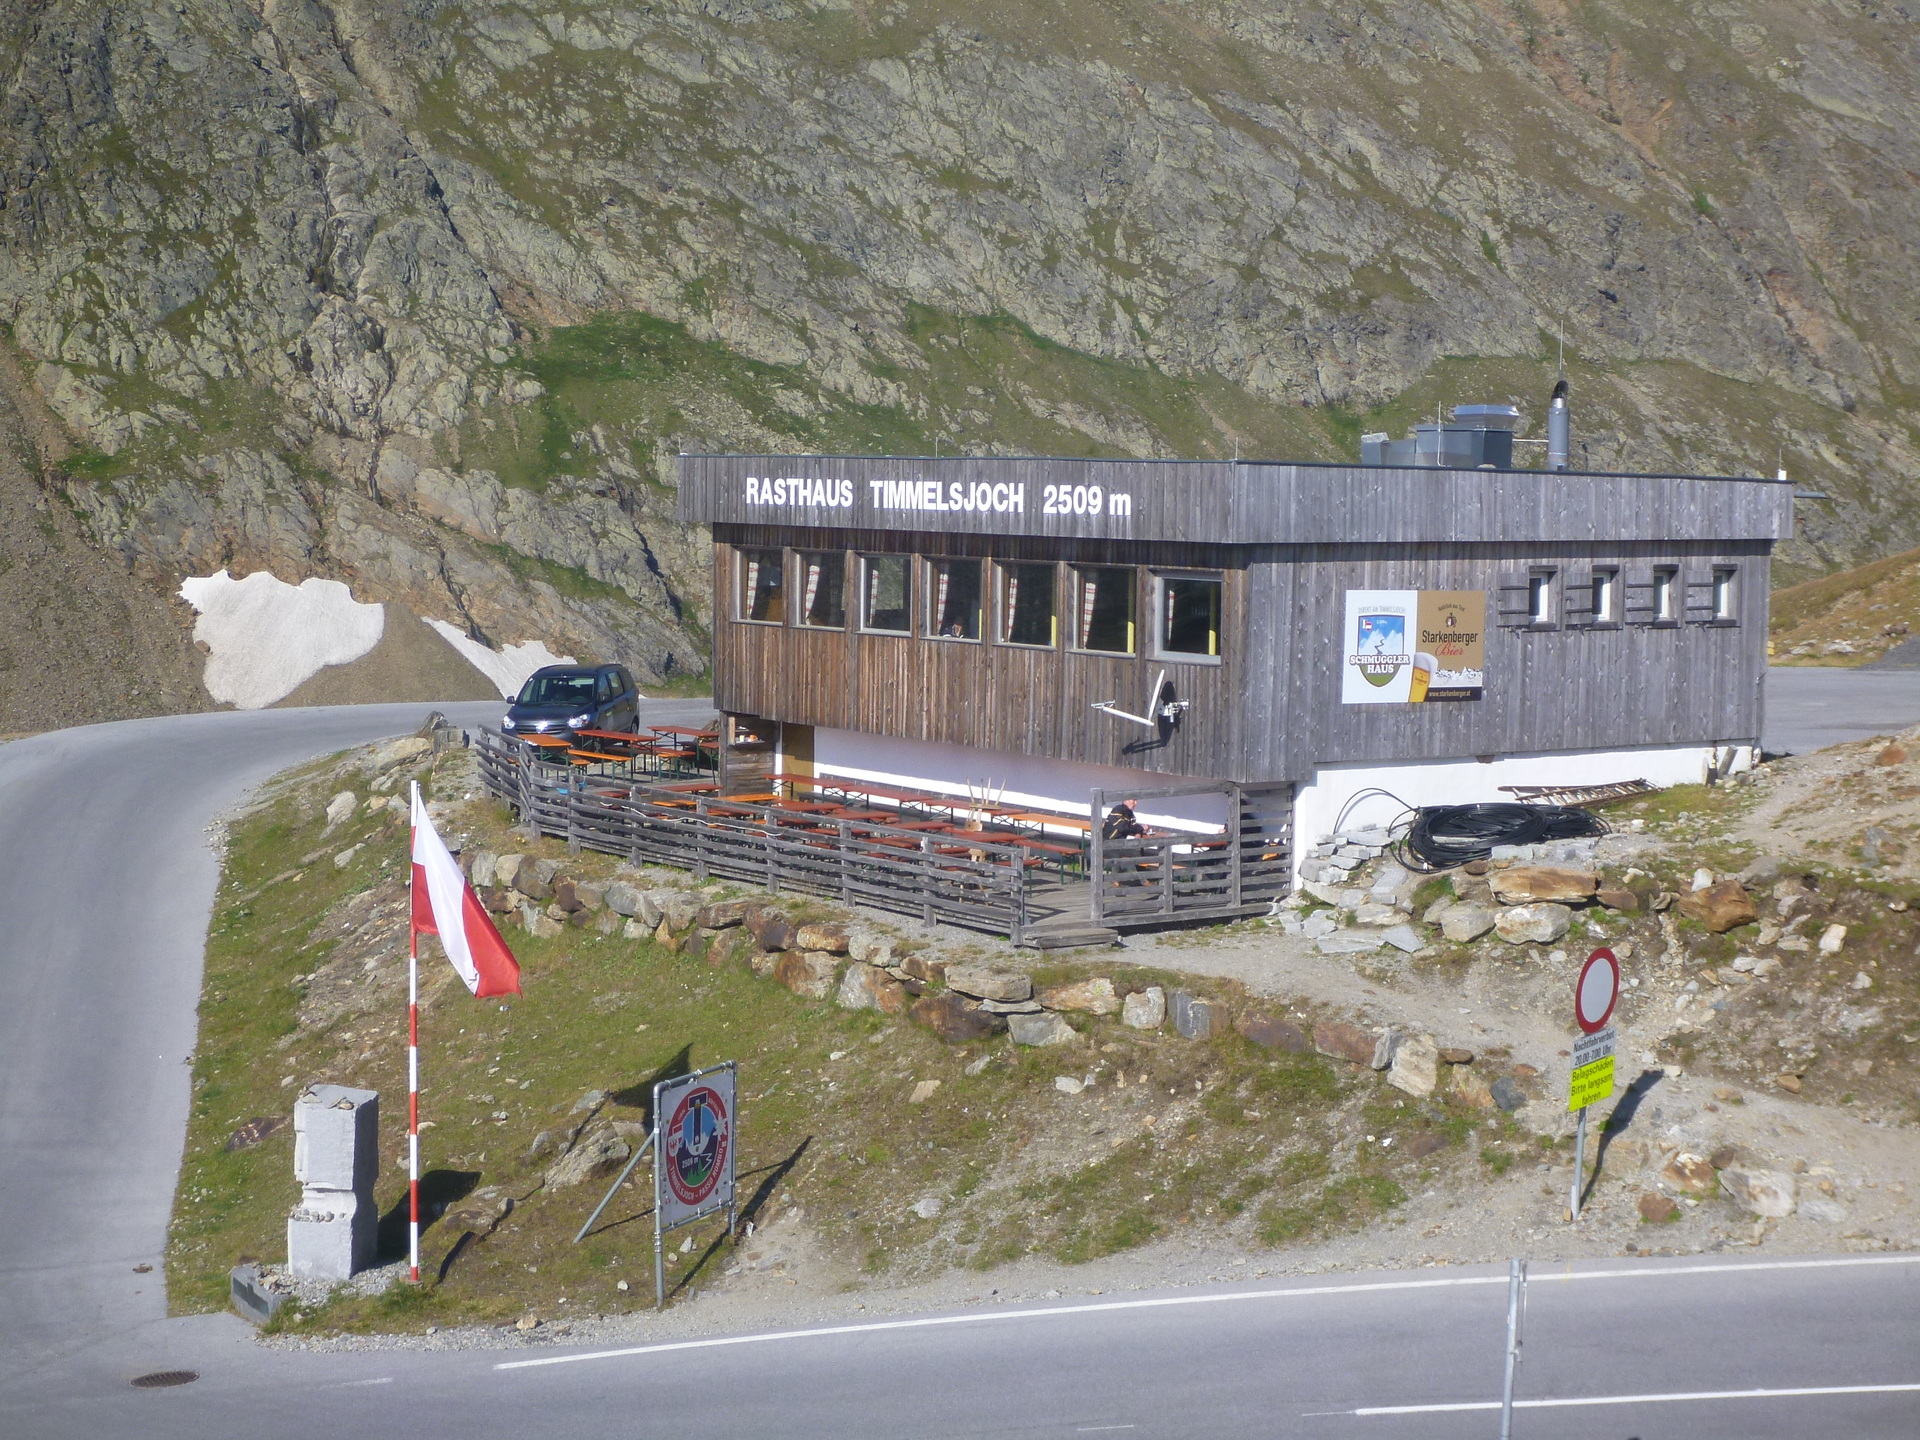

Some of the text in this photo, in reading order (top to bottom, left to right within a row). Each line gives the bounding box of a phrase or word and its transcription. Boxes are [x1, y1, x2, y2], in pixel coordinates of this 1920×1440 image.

[745, 477, 1131, 516] RASTHAUS TIMMELSJOCH 2509 m
[1422, 630, 1478, 646] Starkenberger
[1435, 641, 1464, 656] Bier
[1349, 654, 1410, 664] SCHMUGGLER
[1367, 664, 1394, 674] HAUS
[1429, 690, 1471, 698] www.starkenberger.at
[1573, 1031, 1615, 1053] Nachtfahrverbot
[1602, 1044, 1612, 1056] Uhr
[1572, 1058, 1614, 1082] Belagschäden
[1571, 1073, 1613, 1096] Bitte langsam
[1581, 1090, 1602, 1106] fahren
[699, 1178, 714, 1197] PASSO
[712, 1148, 723, 1178] ROMBO
